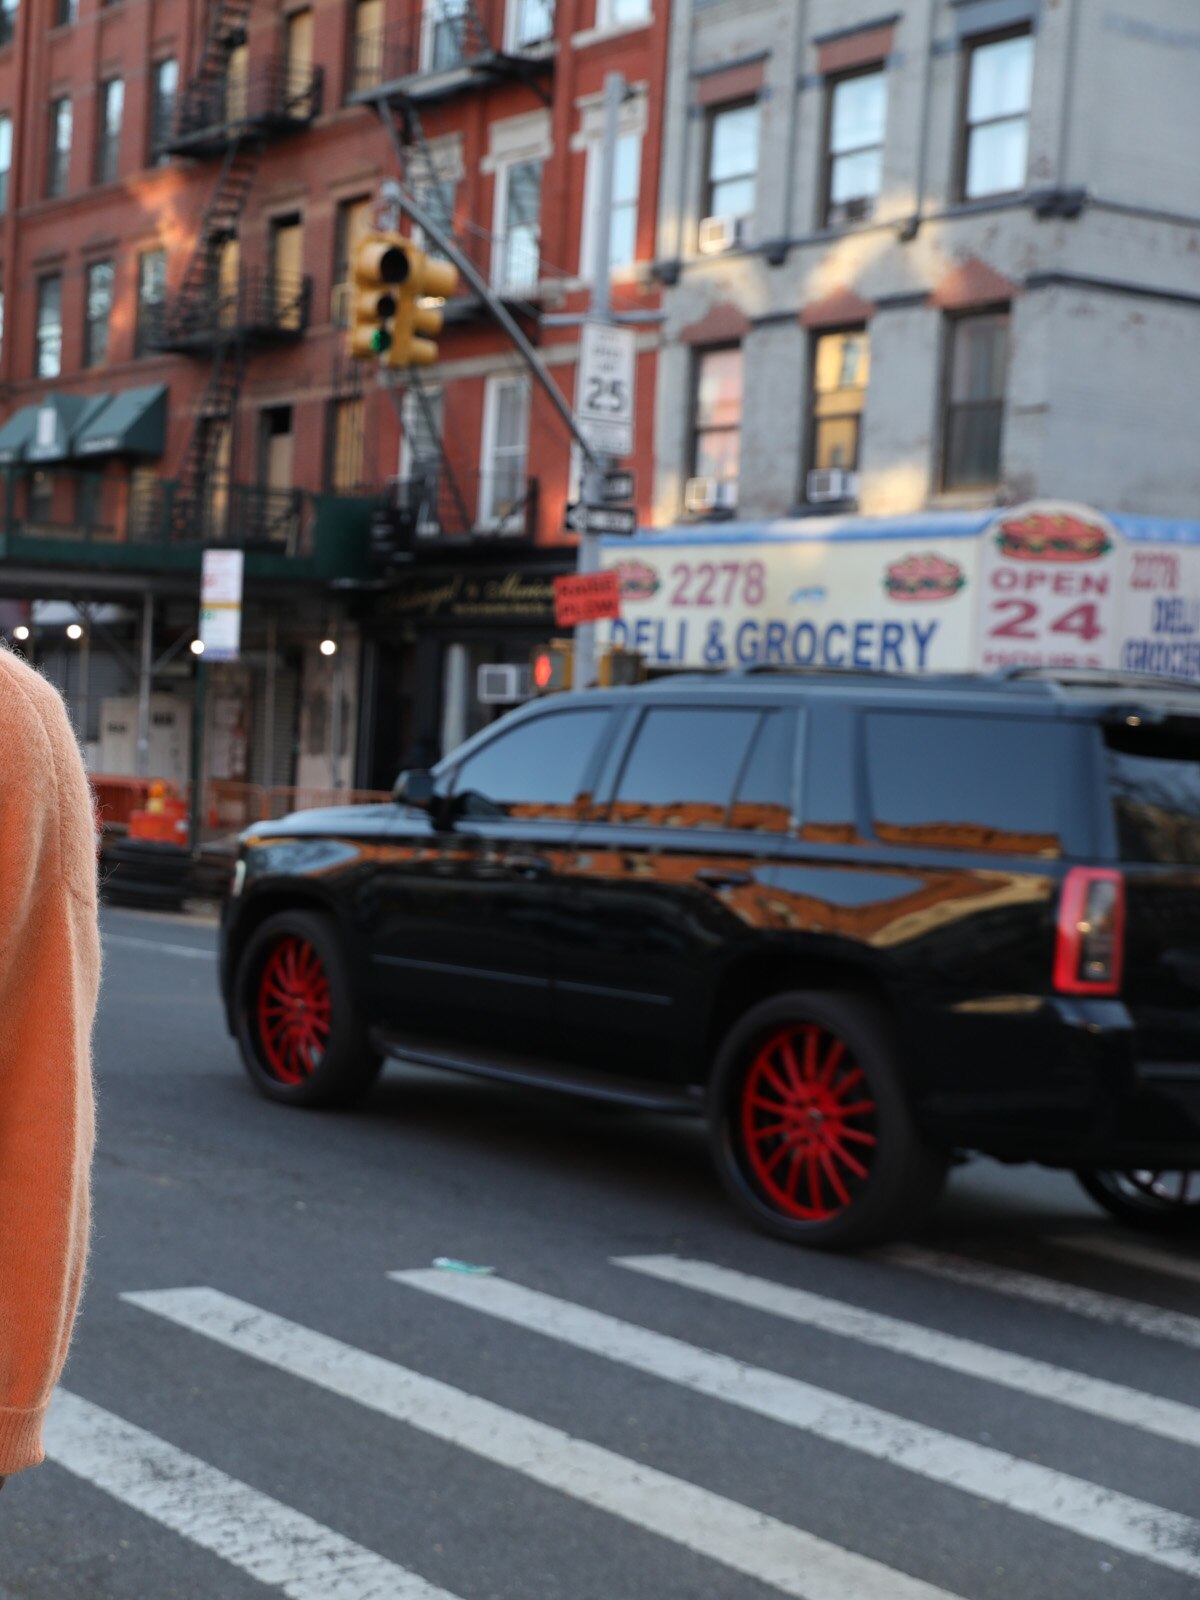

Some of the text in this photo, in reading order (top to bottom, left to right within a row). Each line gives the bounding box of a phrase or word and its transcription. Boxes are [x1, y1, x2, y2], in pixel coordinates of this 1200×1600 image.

[588, 376, 624, 412] 25
[670, 559, 767, 608] 2278
[990, 567, 1110, 595] OPEN
[989, 600, 1103, 642] 24
[610, 616, 938, 671] DELI & GROCERY
